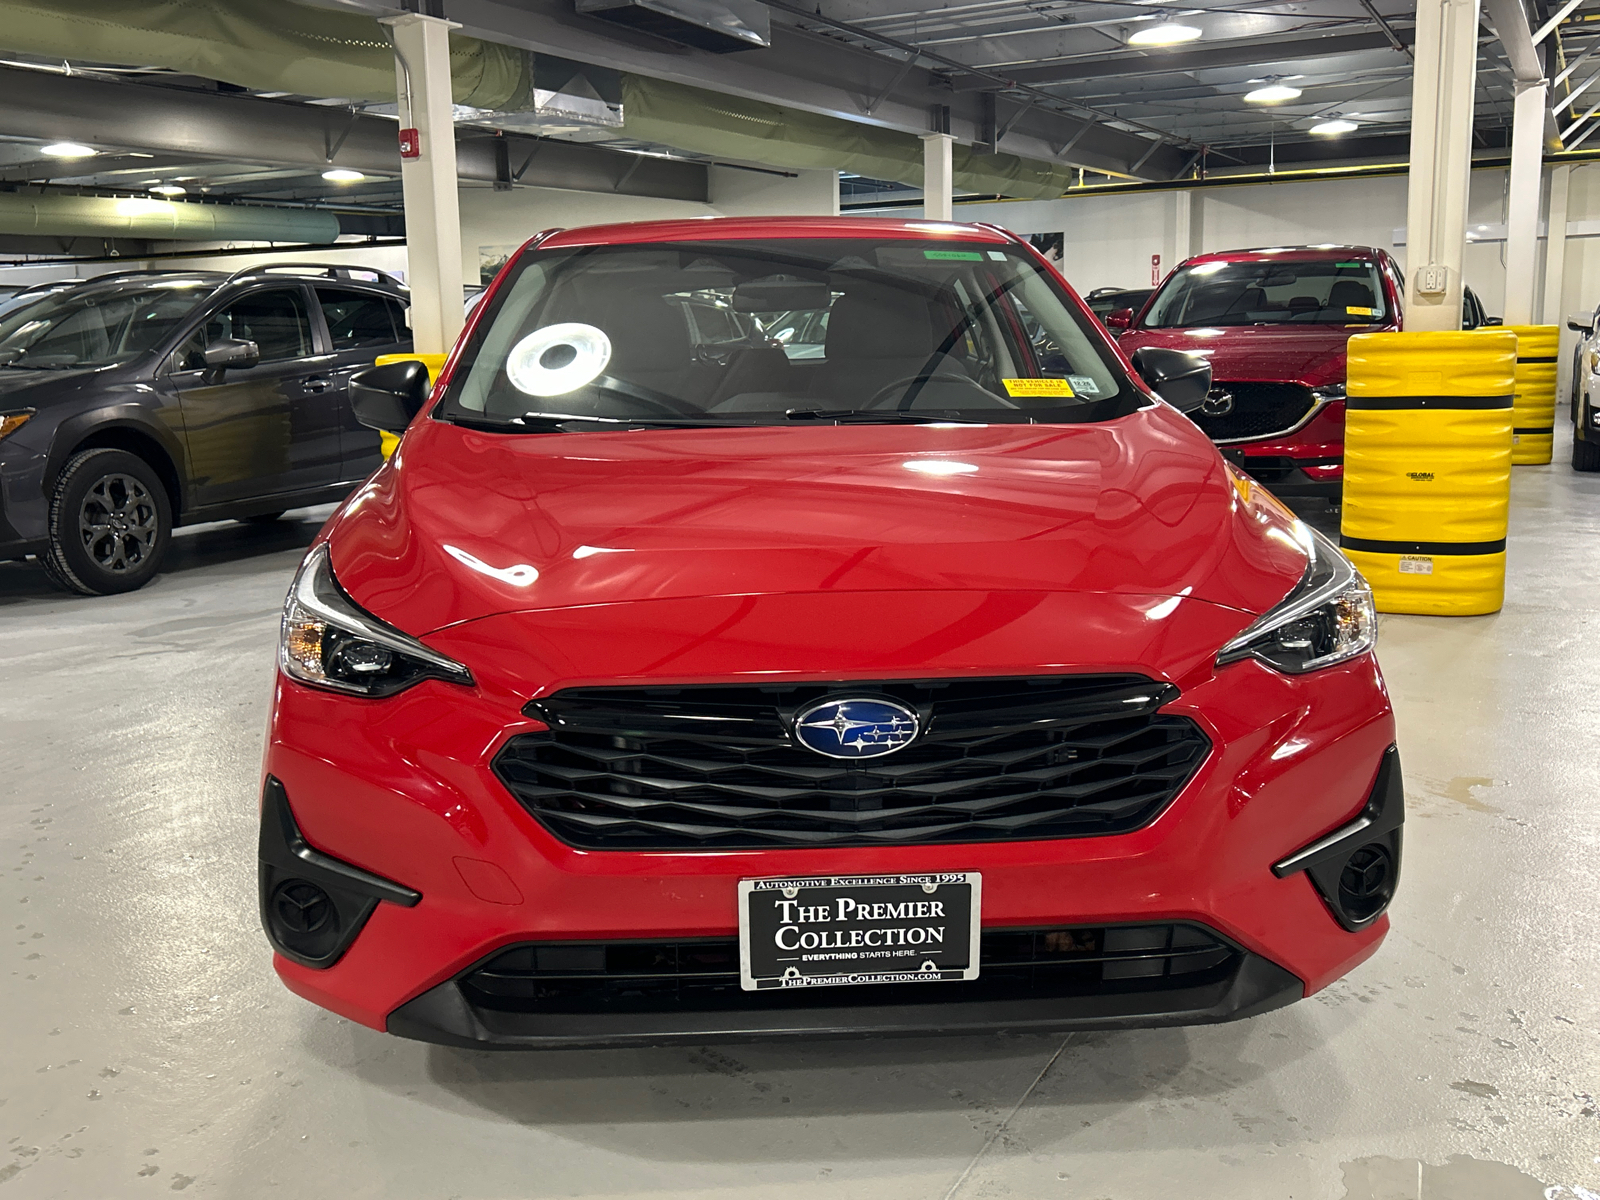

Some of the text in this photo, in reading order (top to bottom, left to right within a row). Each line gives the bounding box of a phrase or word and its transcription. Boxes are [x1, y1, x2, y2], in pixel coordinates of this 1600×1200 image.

[756, 874, 965, 890] AUTOMOTIVE EXCELLENCE SINCE 1995
[774, 897, 946, 924] THE PREMIER
[774, 926, 946, 951] COLLECTION
[802, 949, 918, 962] EVERYTHING STARTS HERE.
